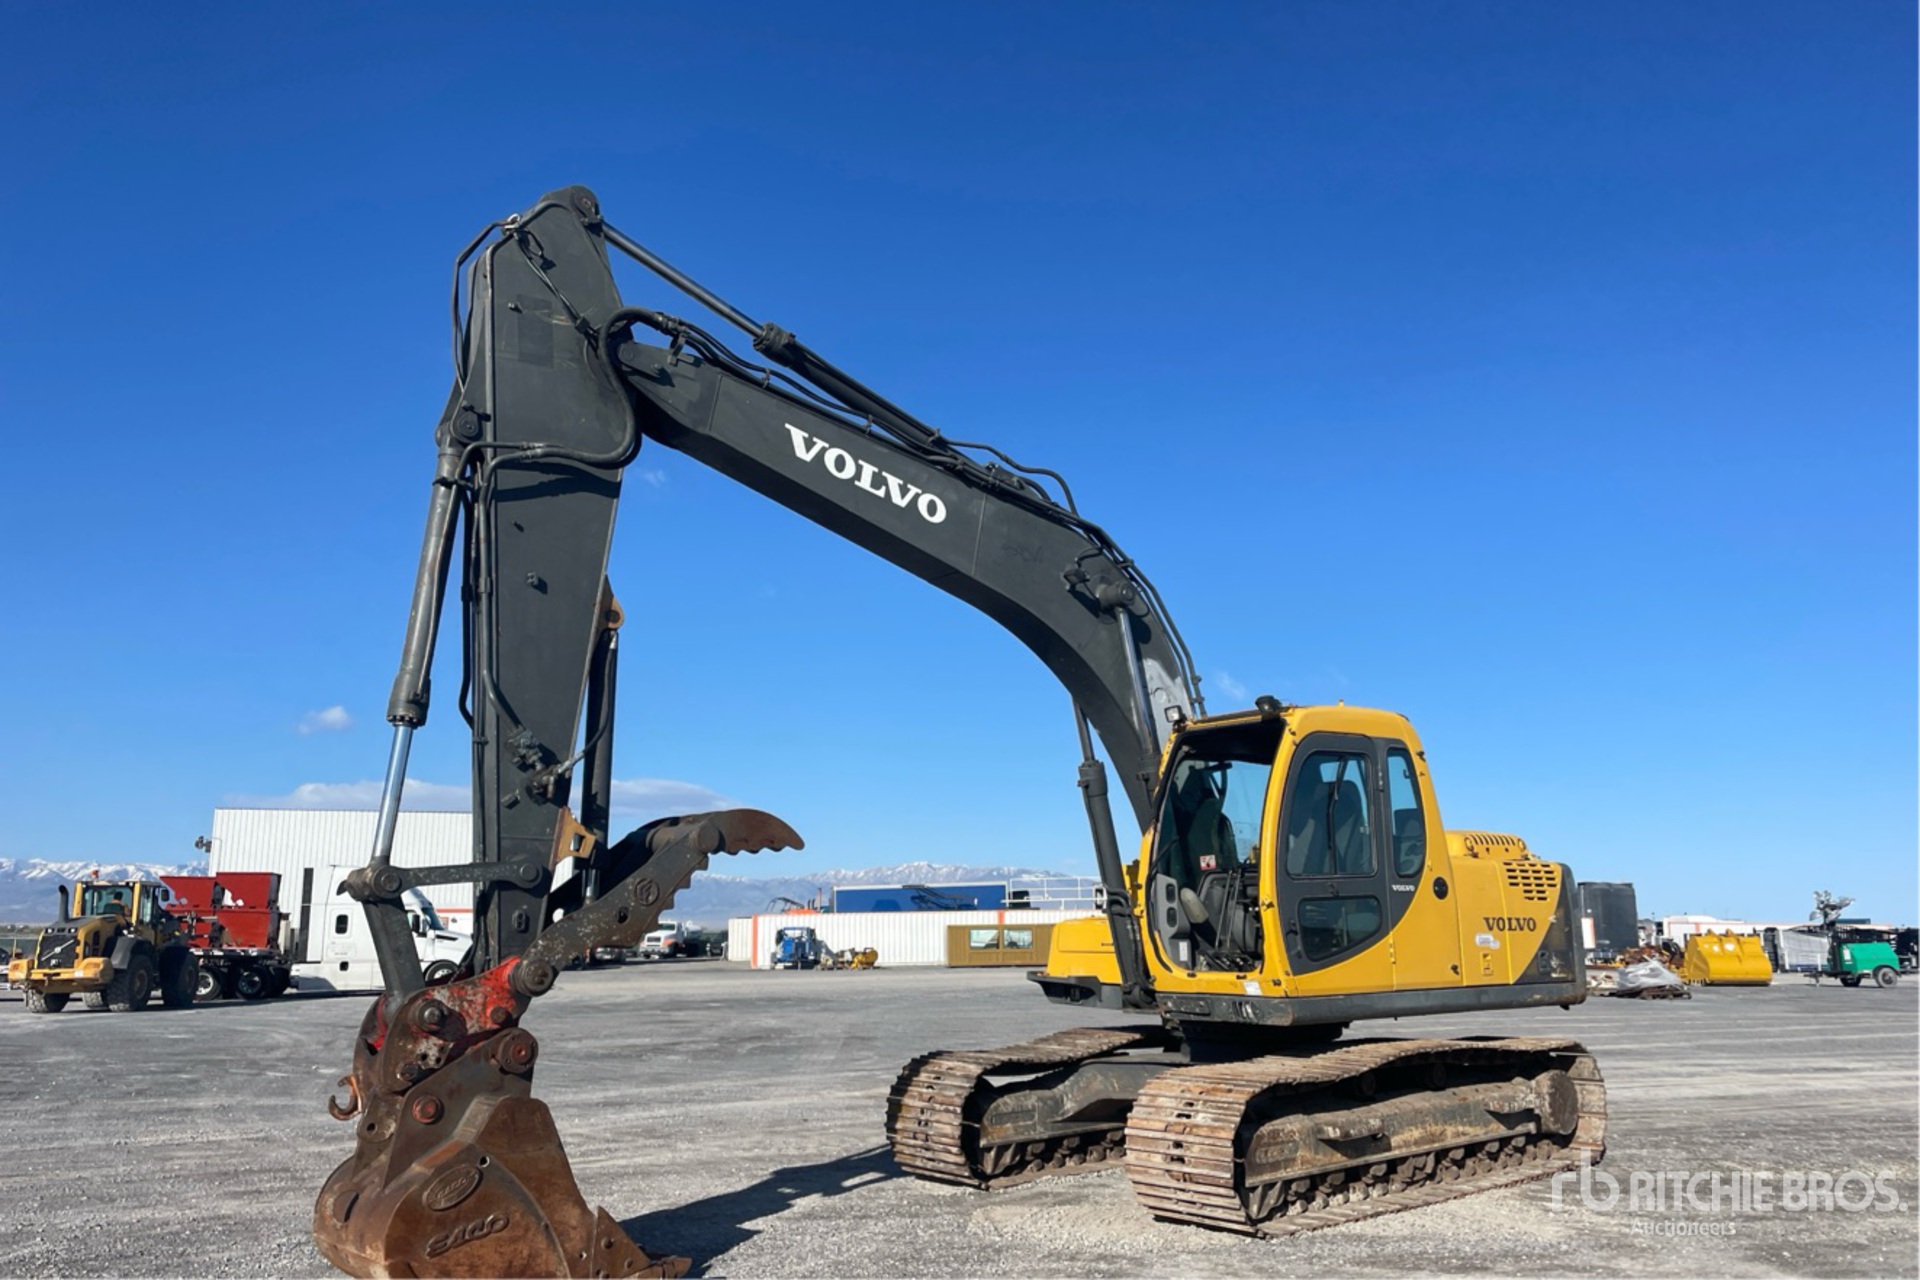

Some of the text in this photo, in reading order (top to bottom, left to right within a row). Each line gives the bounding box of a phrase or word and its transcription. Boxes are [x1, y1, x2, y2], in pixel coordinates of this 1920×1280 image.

[784, 423, 947, 523] VOLVO
[1391, 884, 1416, 892] VOLVO
[1483, 916, 1537, 932] VOLVO
